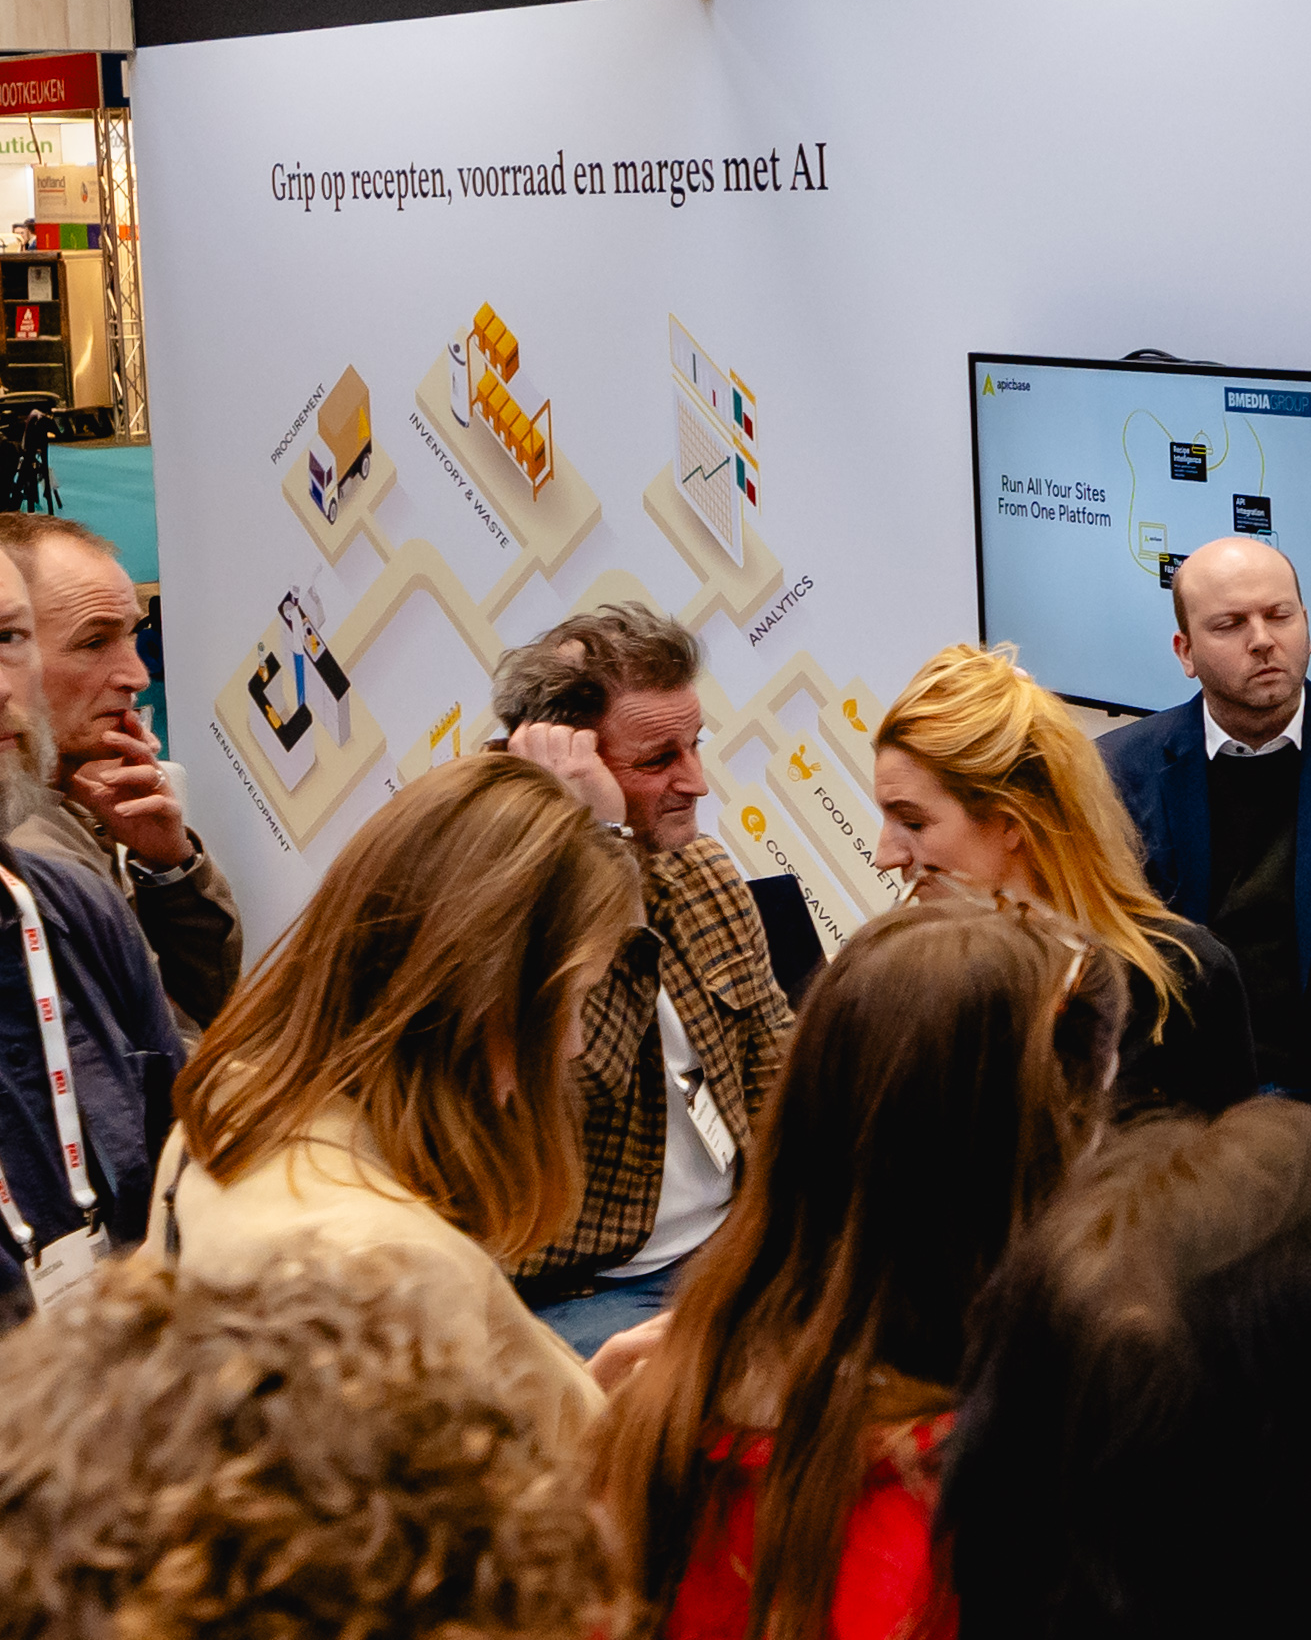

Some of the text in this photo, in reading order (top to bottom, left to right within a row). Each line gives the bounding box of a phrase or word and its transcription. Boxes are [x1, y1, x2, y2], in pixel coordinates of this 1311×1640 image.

[0, 78, 65, 107] OOTKEUKEN
[271, 142, 829, 212] Grip op recepten, voorraad en marges met AI
[996, 377, 1031, 392] apicbase
[270, 383, 327, 465] PROCUREMENT
[408, 412, 510, 549] INVENTORY & WASTE
[1001, 475, 1106, 502] Run All Your Sites
[998, 497, 1112, 527] From One Platform
[748, 575, 815, 647] ANALYTICS
[209, 721, 292, 853] MENU DEVELOPMENT
[813, 785, 854, 837] FOOD
